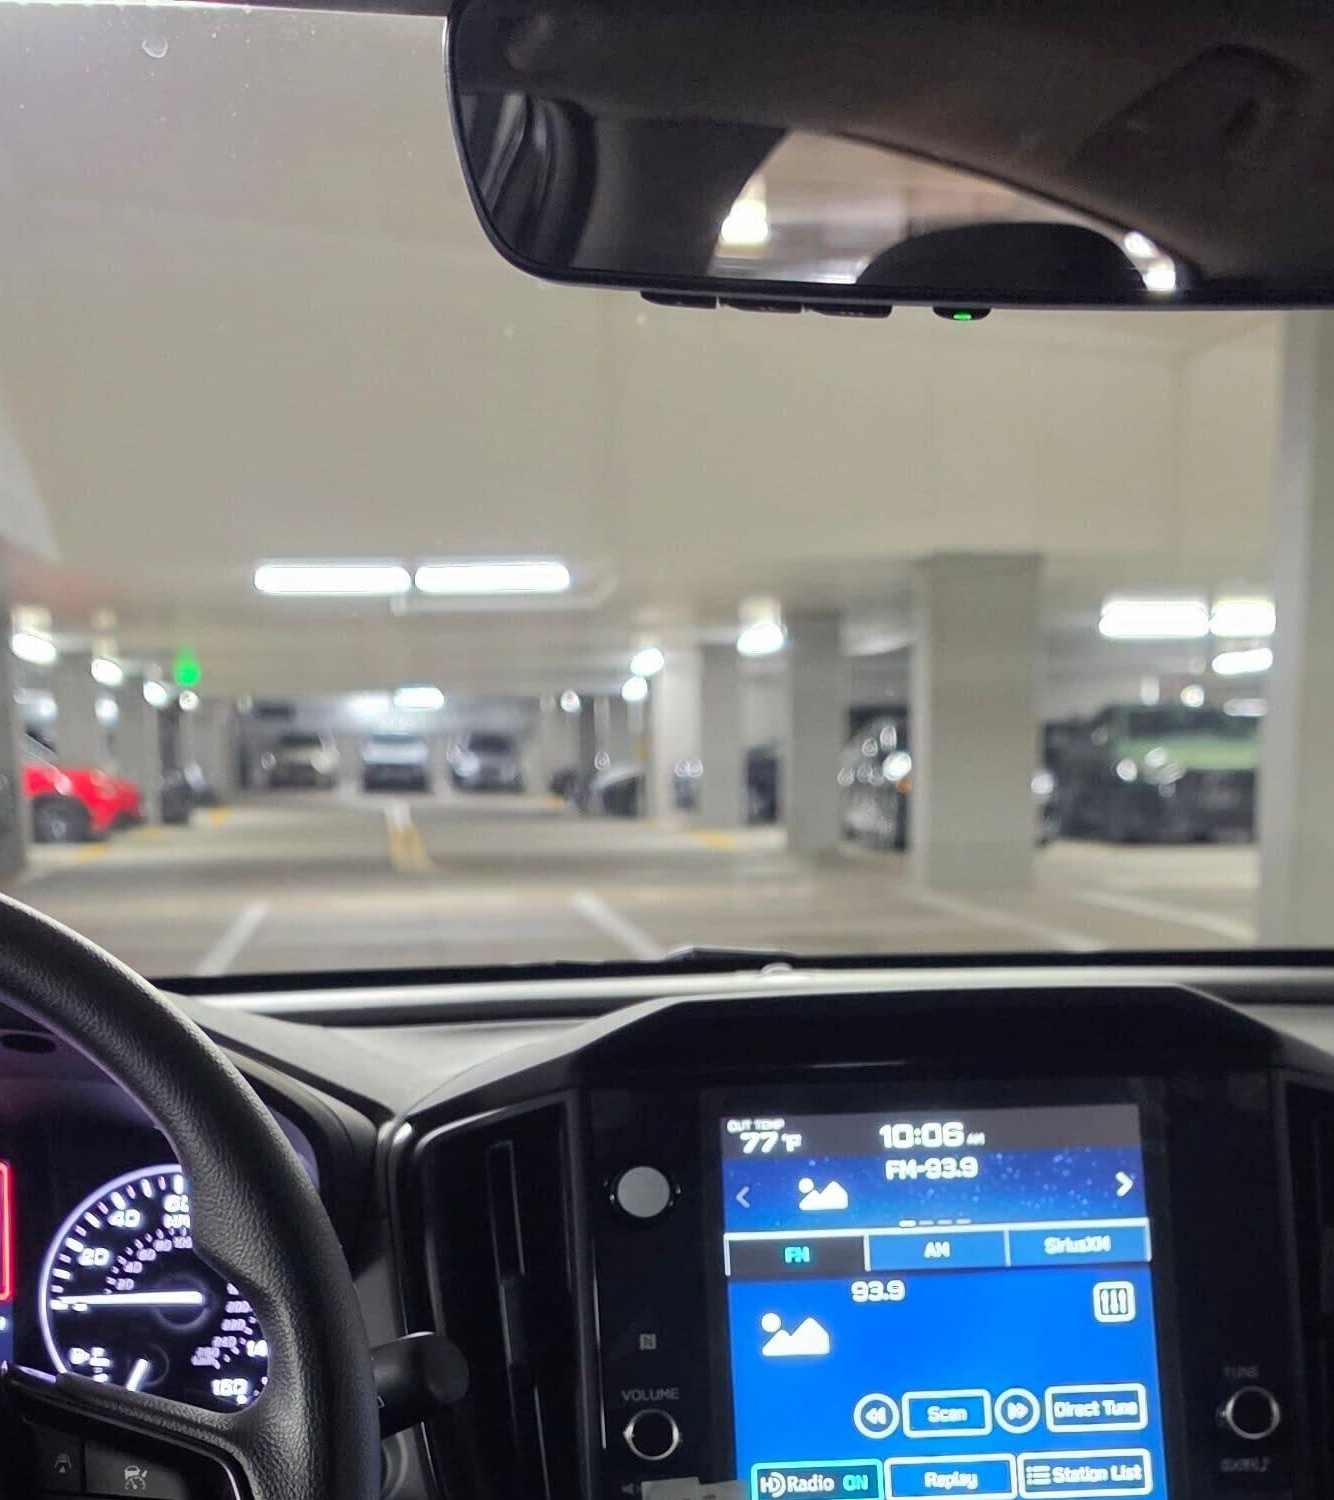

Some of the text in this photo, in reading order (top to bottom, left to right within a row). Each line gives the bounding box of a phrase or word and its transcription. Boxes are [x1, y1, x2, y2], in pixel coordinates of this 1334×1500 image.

[726, 1118, 786, 1133] OUT TEMP
[740, 1131, 779, 1154] 77
[885, 1156, 979, 1181] FM-93.9
[108, 1209, 141, 1228] 40
[923, 1241, 951, 1259] AM
[1043, 1235, 1112, 1255] SiriusXM
[78, 1248, 111, 1267] 20
[784, 1246, 811, 1264] FM
[850, 1279, 906, 1303] 93.9
[246, 1339, 268, 1357] 14
[211, 1378, 248, 1396] 160
[622, 1388, 682, 1401] VOLUME
[926, 1405, 968, 1423] Scan
[1054, 1399, 1138, 1419] Direct Tune
[924, 1470, 979, 1490] Replay
[1051, 1463, 1143, 1484] Station List
[787, 1474, 835, 1493] Radio
[842, 1474, 869, 1492] ON
